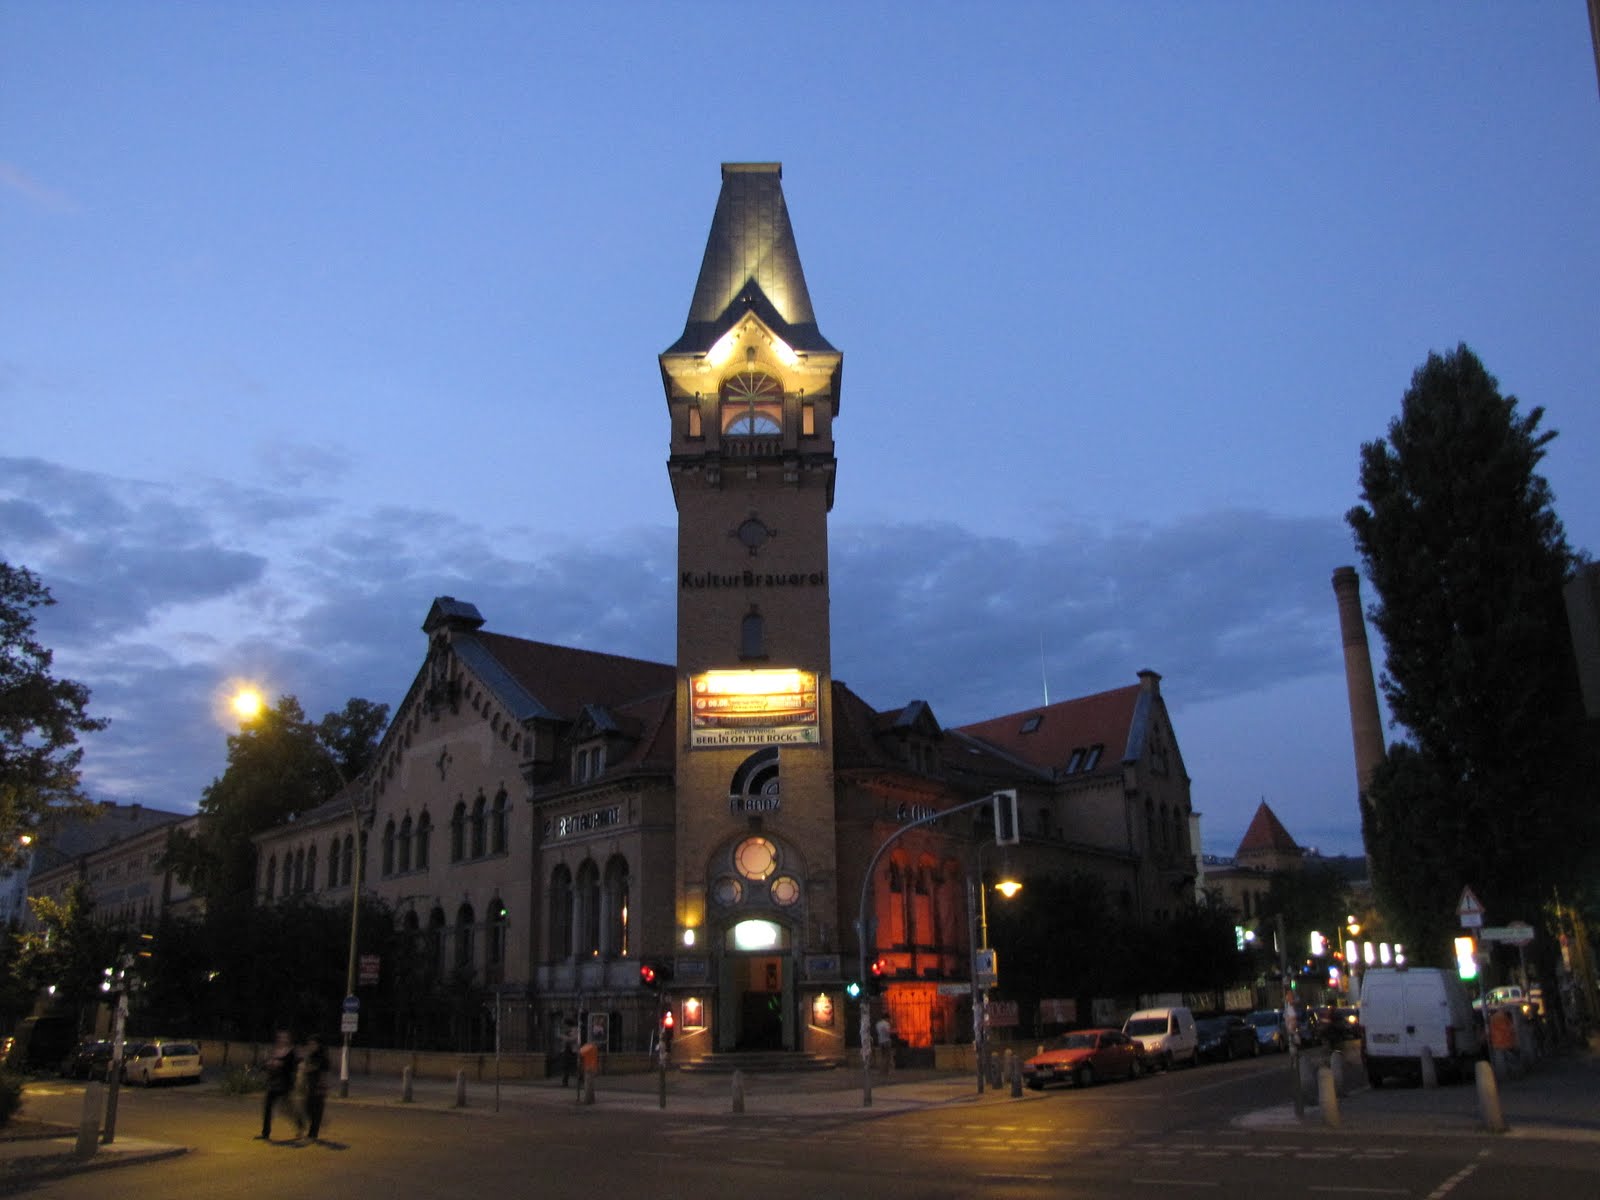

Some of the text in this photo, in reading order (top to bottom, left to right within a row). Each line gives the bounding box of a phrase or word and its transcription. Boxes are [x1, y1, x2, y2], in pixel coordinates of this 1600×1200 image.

[681, 570, 825, 588] KulturBrauerei
[731, 735, 745, 743] ON
[747, 734, 765, 743] THE
